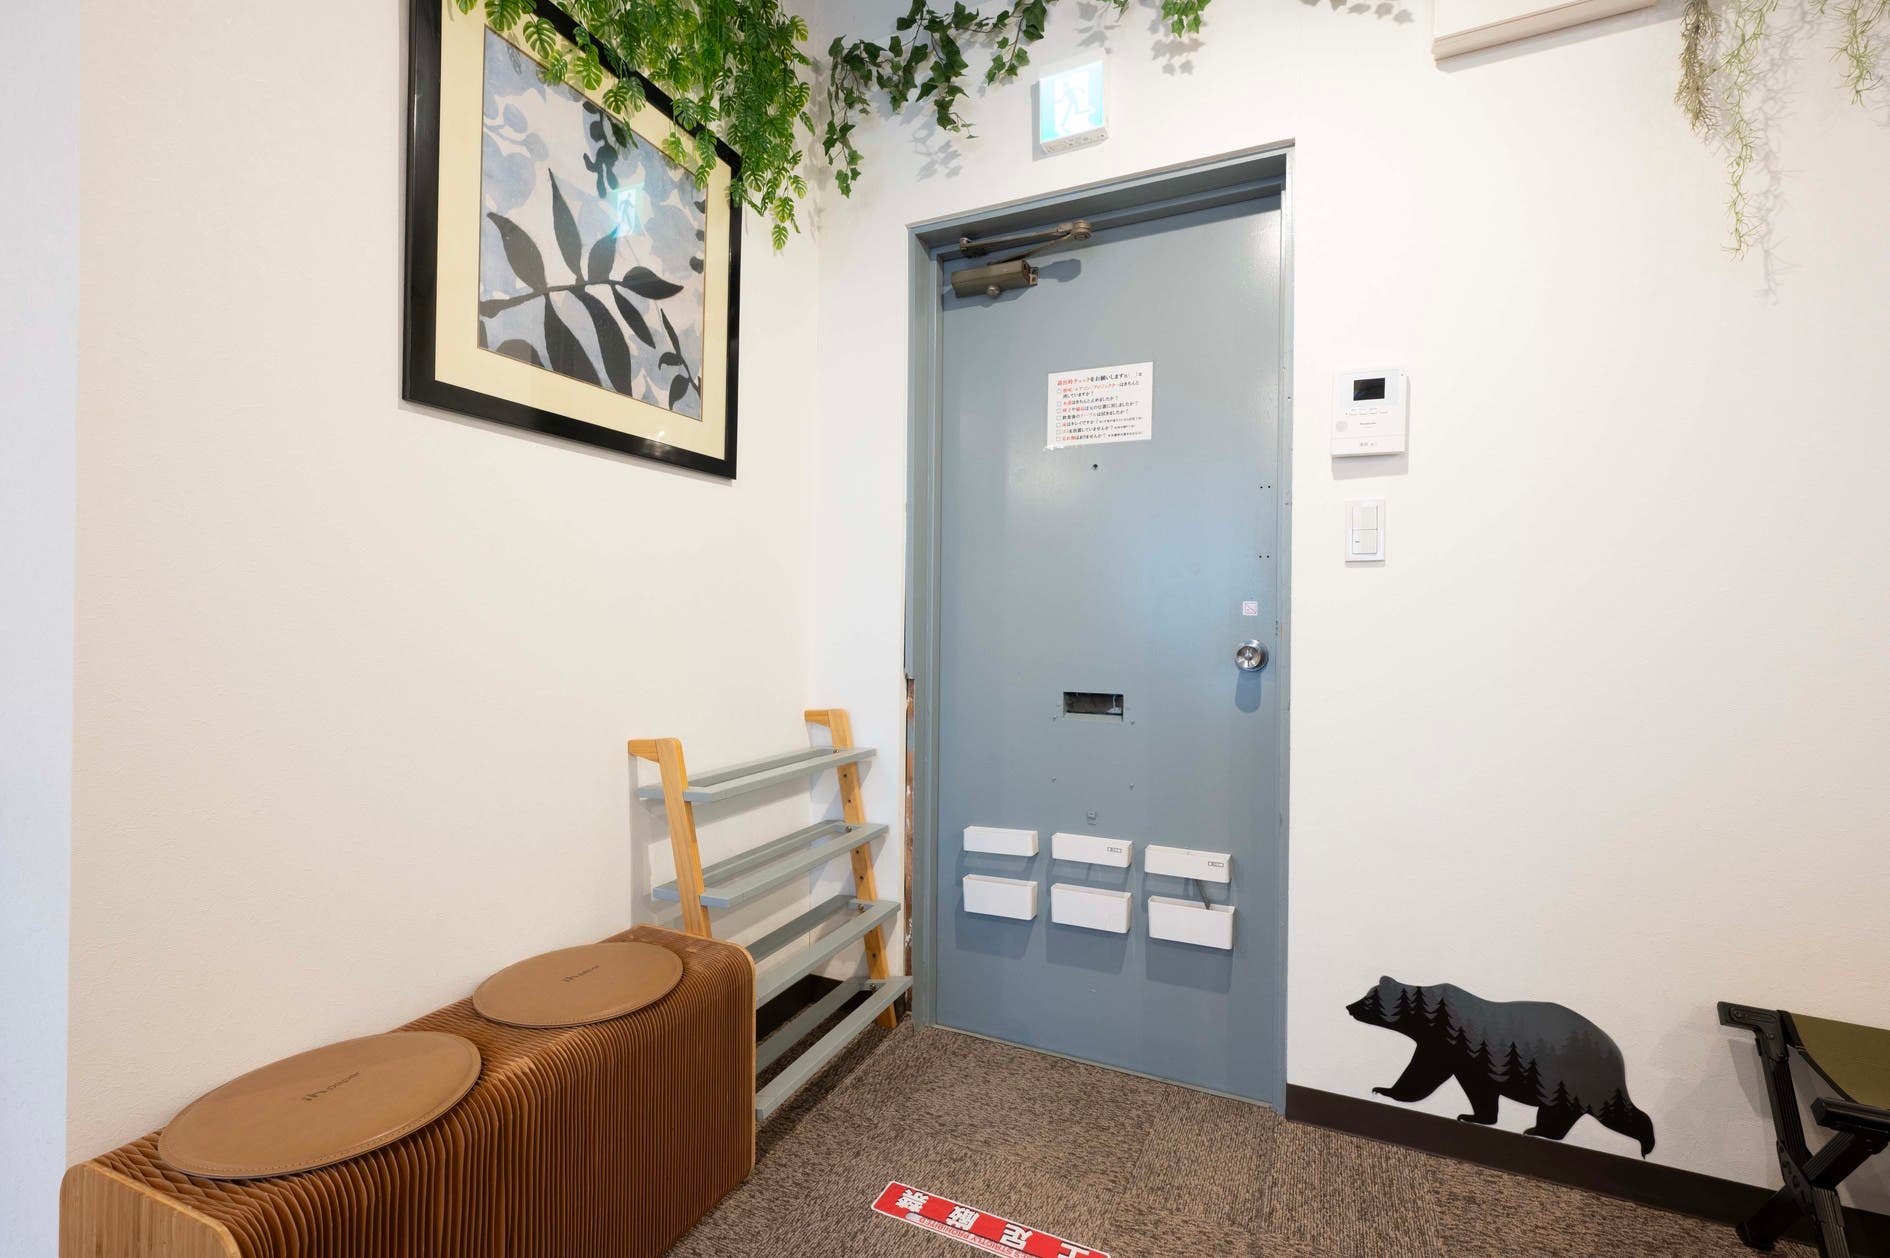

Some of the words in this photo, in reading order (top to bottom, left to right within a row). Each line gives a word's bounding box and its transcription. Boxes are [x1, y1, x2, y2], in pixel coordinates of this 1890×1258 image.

[896, 1189, 1090, 1258] 土足厳禁
[919, 1216, 970, 1239] PROHIBITED
[971, 1234, 1013, 1255] STRICTLY
